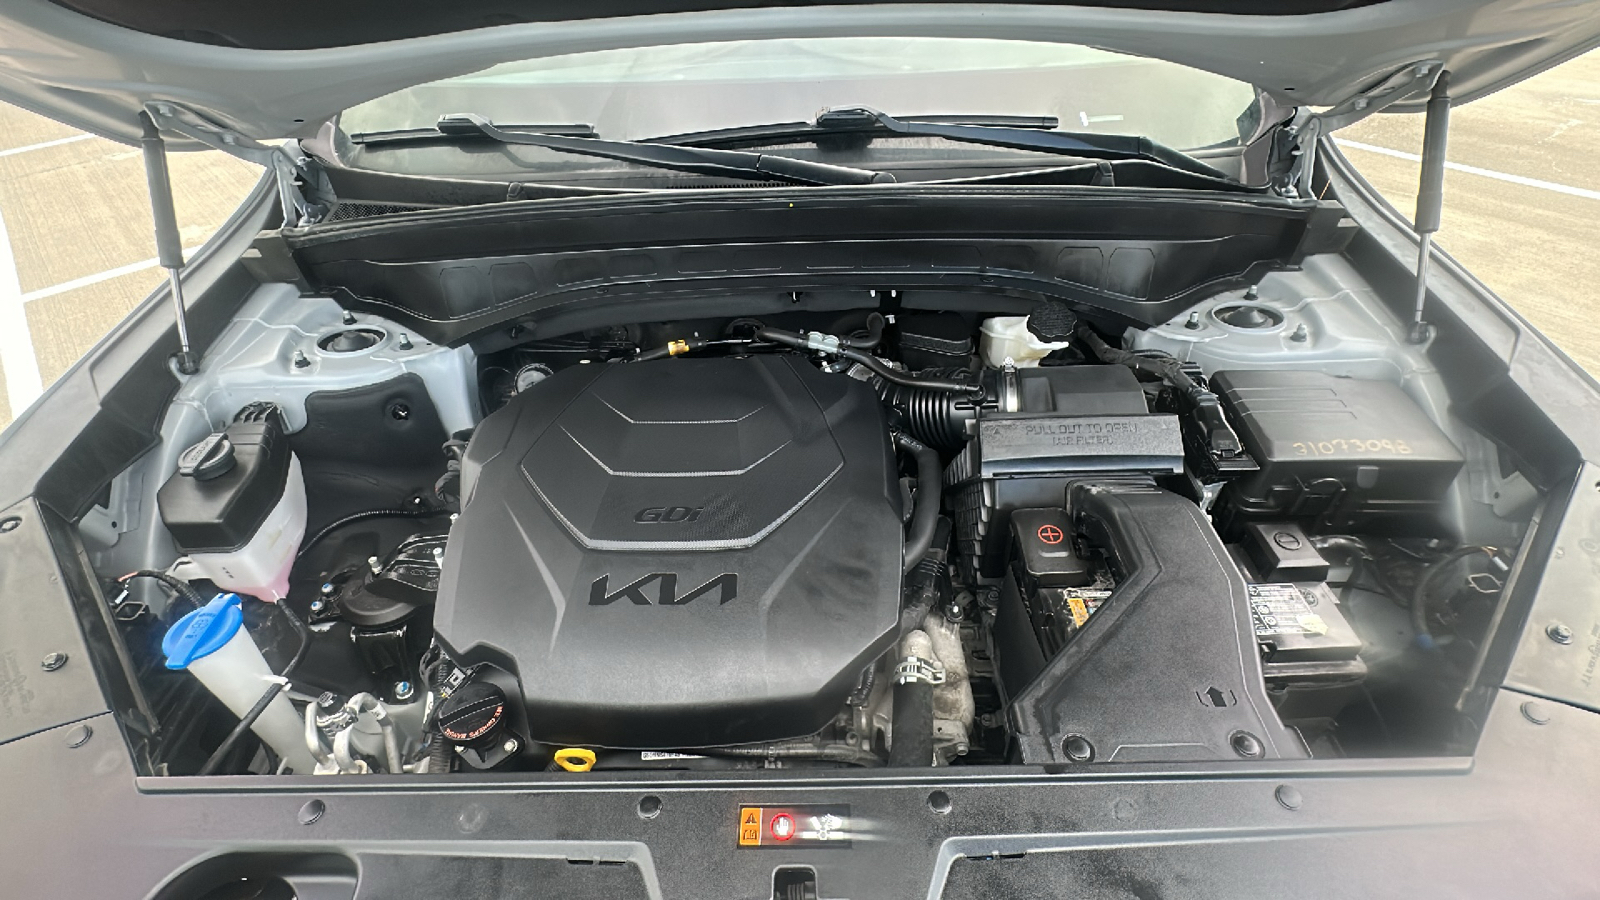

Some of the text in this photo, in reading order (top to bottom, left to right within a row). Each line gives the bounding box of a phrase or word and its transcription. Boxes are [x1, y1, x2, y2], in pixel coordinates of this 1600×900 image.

[1025, 422, 1137, 435] PULL OUT TO OPEN
[588, 572, 739, 606] KIA
